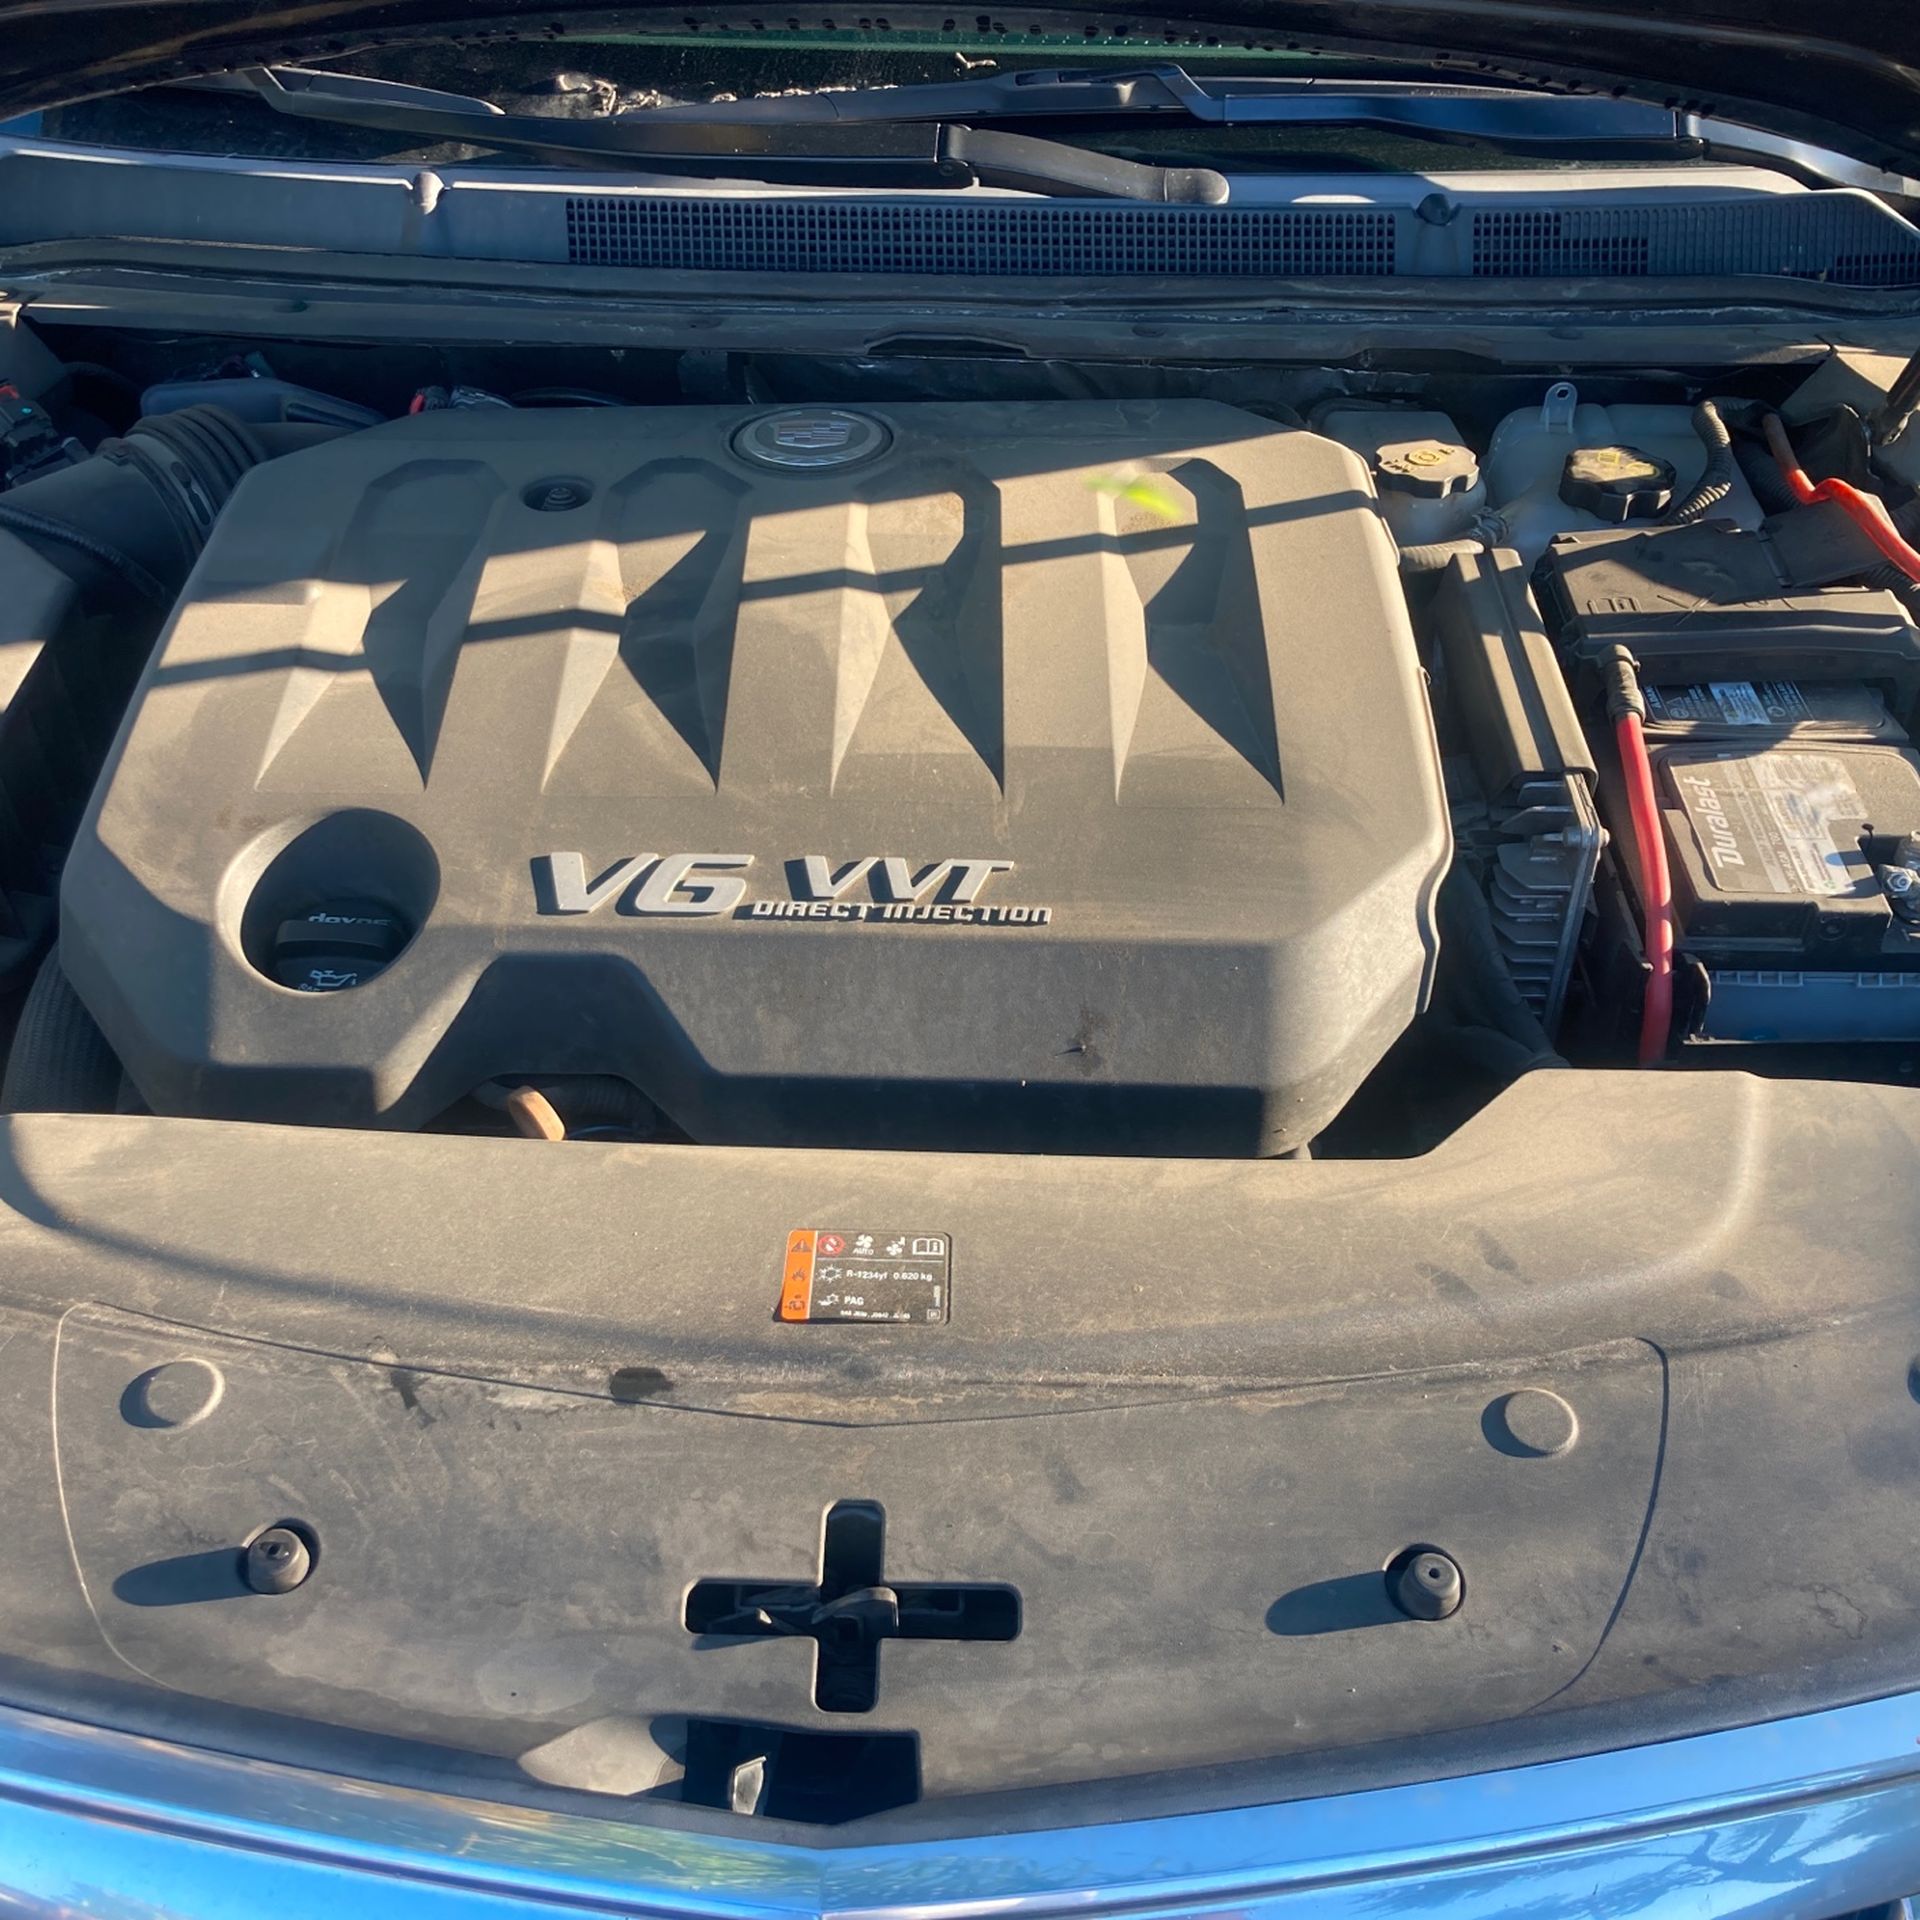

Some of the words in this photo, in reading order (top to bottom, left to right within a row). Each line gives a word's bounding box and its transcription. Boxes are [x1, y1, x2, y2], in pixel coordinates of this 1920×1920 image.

[1681, 774, 1746, 867] Duralast
[549, 851, 754, 912] V6
[804, 854, 1015, 904] VVT
[752, 900, 875, 919] DIRECT
[882, 902, 1054, 923] INJECTION
[846, 1269, 888, 1281] R-1234yf
[920, 1272, 933, 1282] kg
[844, 1295, 864, 1306] PAG
